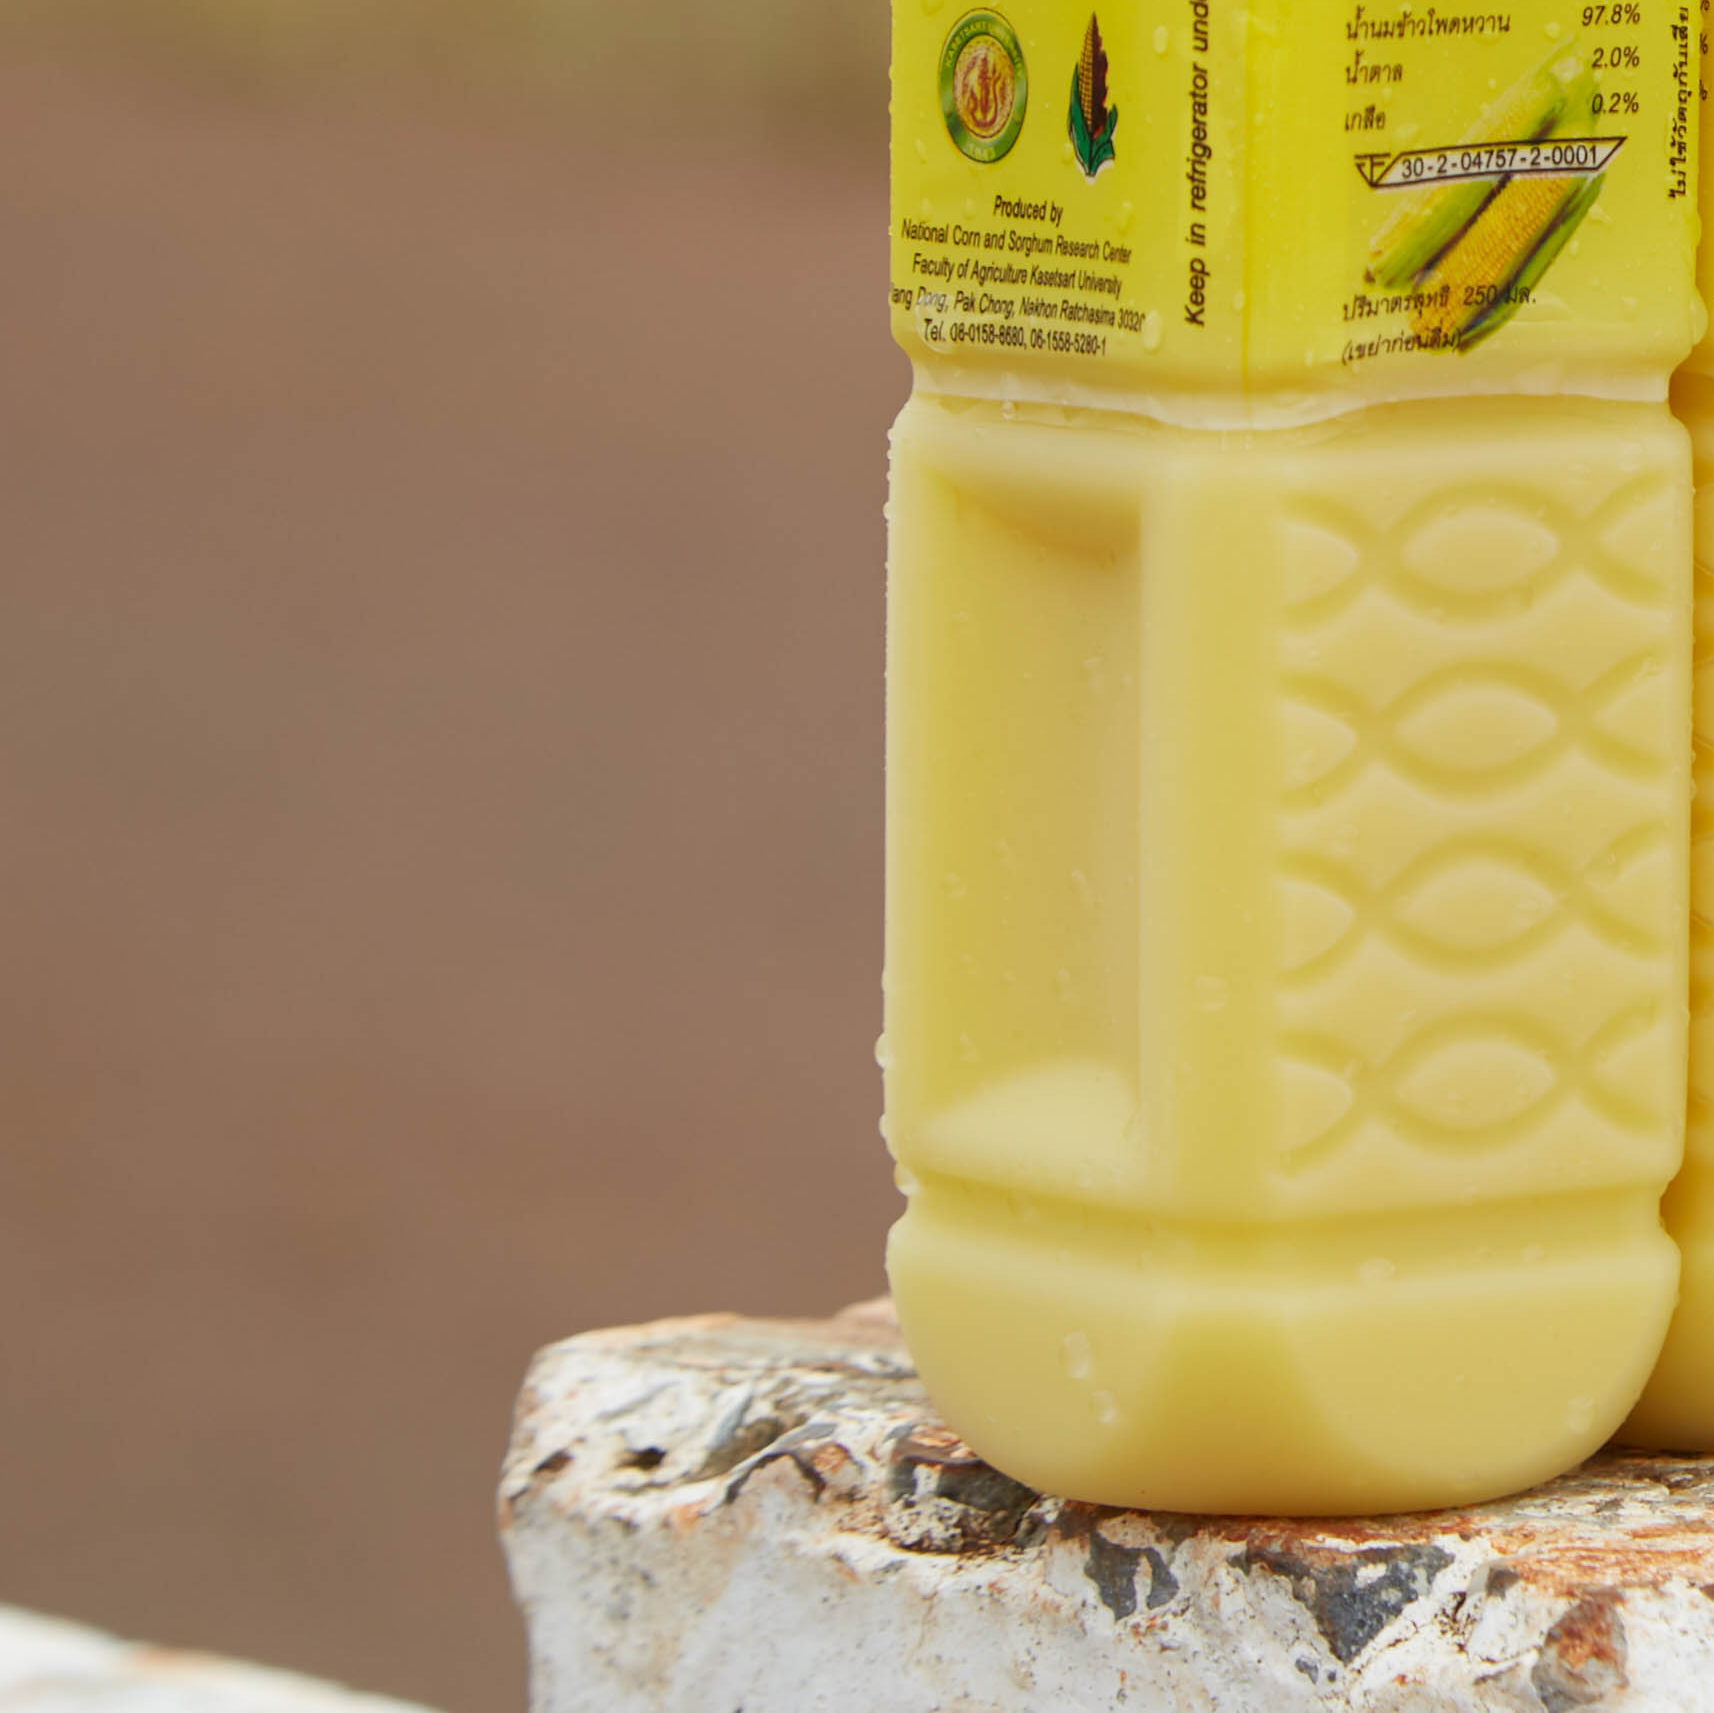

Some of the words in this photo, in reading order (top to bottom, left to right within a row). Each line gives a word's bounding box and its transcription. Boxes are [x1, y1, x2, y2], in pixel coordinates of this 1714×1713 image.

[1345, 6, 1512, 42] น้ำนมข้าวโพดหวาน
[1581, 1, 1642, 29] 97.8%
[1345, 51, 1404, 86] น้ำตาล
[1591, 44, 1641, 71] 2.0%
[1344, 104, 1387, 134] เกลือ
[1591, 92, 1641, 116] 0.2%
[1185, 61, 1213, 213] refrigerator
[992, 195, 1047, 222] Produced
[1049, 200, 1064, 228] by
[901, 218, 949, 245] National
[952, 224, 983, 247] Corn
[983, 229, 1005, 251] and
[1008, 229, 1054, 258] Sorghum
[1055, 234, 1100, 262] Research
[1102, 240, 1133, 265] Center
[1185, 222, 1207, 248] in
[912, 252, 955, 283] Faculty
[957, 257, 970, 280] of
[970, 259, 1028, 287] Agriculture
[1030, 263, 1076, 290] Kasetsart
[1077, 269, 1123, 301] University
[1183, 256, 1212, 328] Keep
[1462, 285, 1498, 307] 250
[953, 290, 976, 314] Pak
[978, 292, 1015, 320] Chong,
[1059, 299, 1116, 327] Ratchasima
[922, 317, 947, 343] Tel.
[1029, 327, 1107, 358] 06-1558-5280-1
